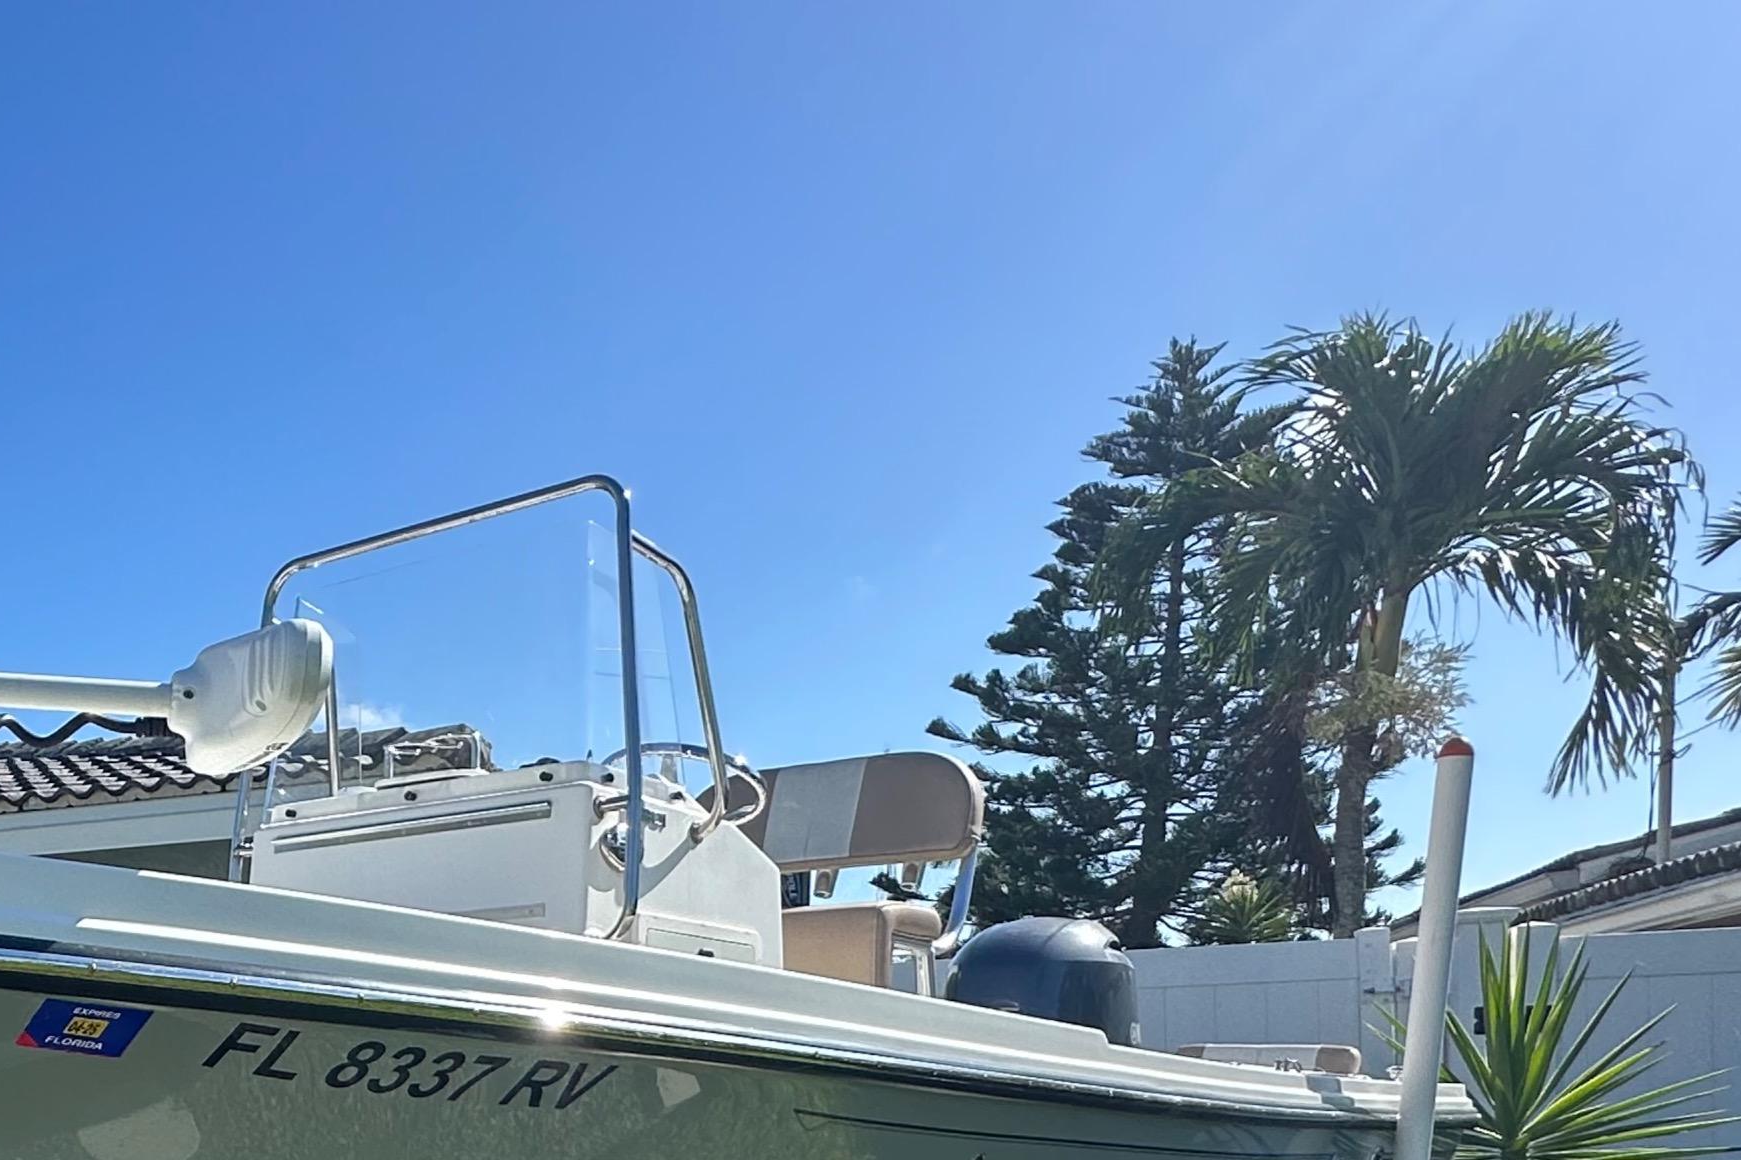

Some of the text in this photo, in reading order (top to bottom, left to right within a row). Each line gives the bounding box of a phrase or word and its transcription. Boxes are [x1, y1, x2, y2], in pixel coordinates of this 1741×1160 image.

[72, 1006, 122, 1020] EXPIRES
[45, 1035, 104, 1050] FLORIDA
[201, 1021, 620, 1110] FL 8337 RV
